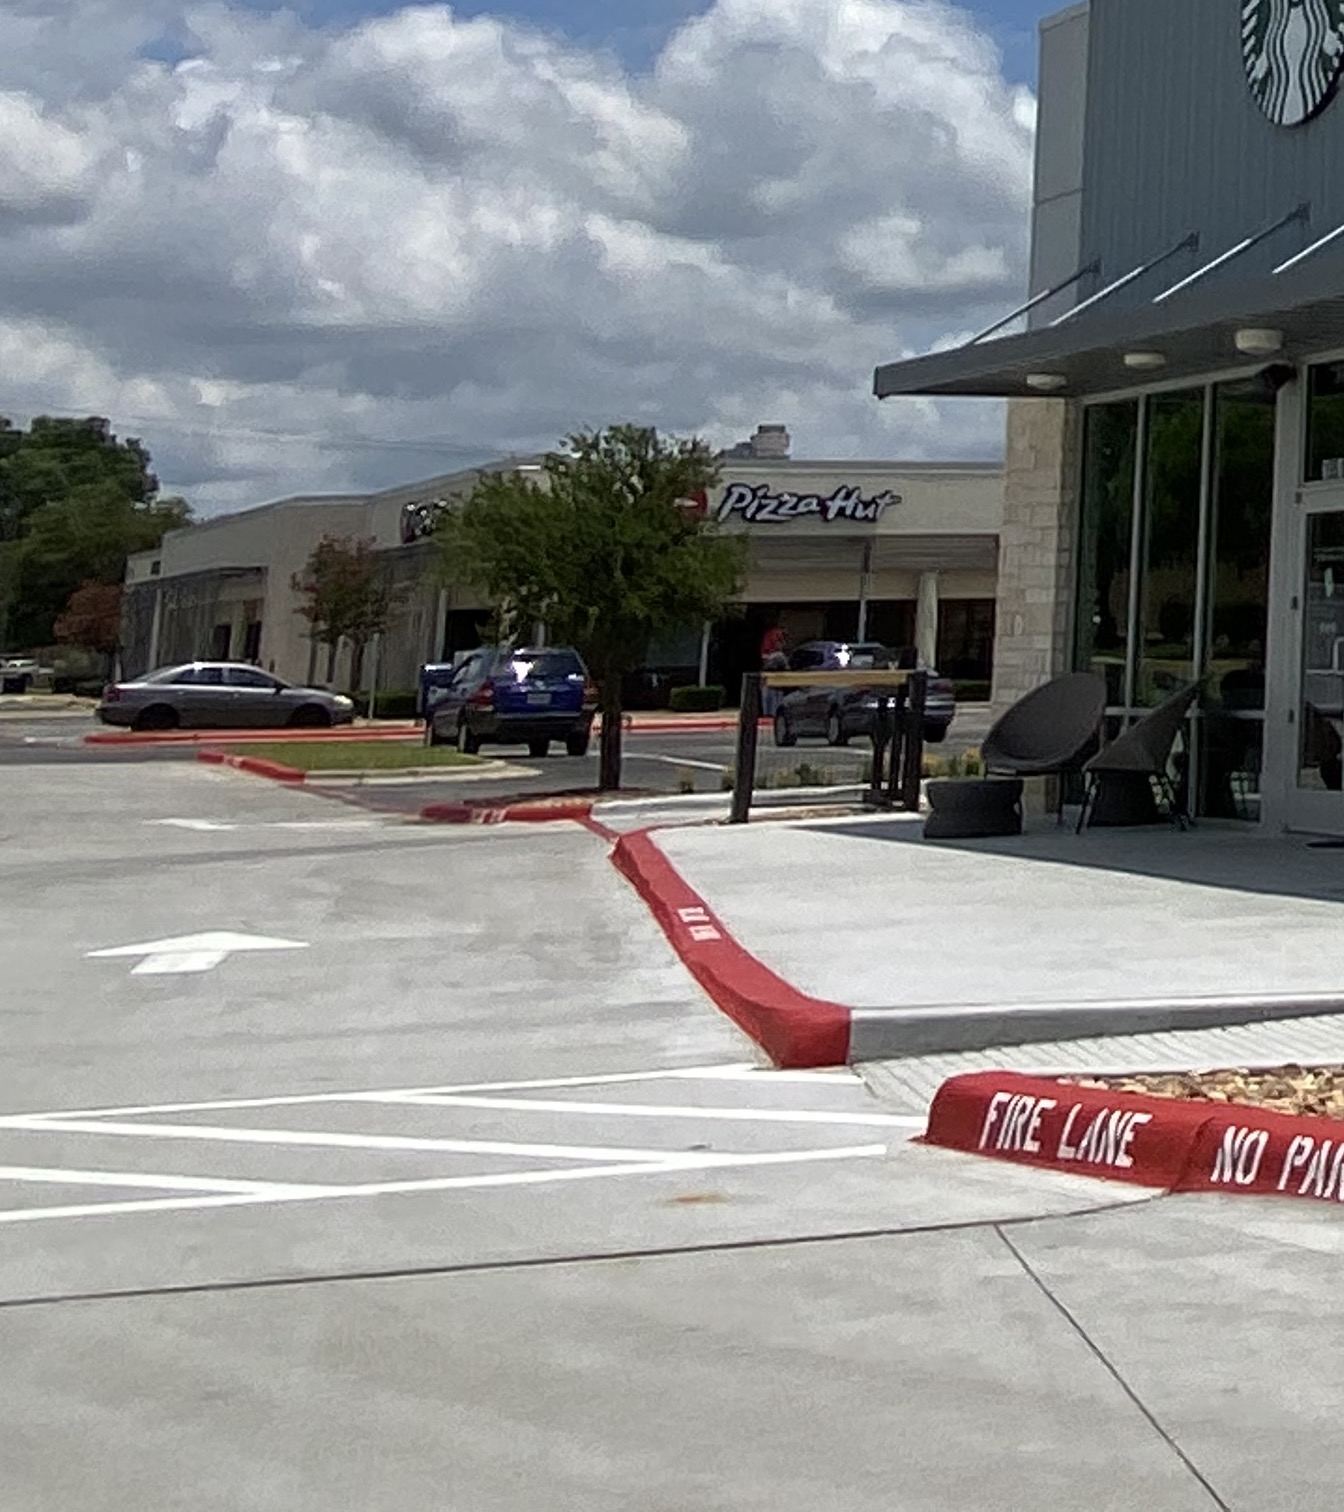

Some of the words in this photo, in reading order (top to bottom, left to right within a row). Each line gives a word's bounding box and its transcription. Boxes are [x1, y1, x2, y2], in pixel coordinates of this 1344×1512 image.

[718, 483, 820, 523] Pizza
[822, 485, 902, 523] Hut
[979, 1092, 1057, 1152] FIRE
[1057, 1103, 1153, 1168] LANE
[1210, 1126, 1268, 1184] NO
